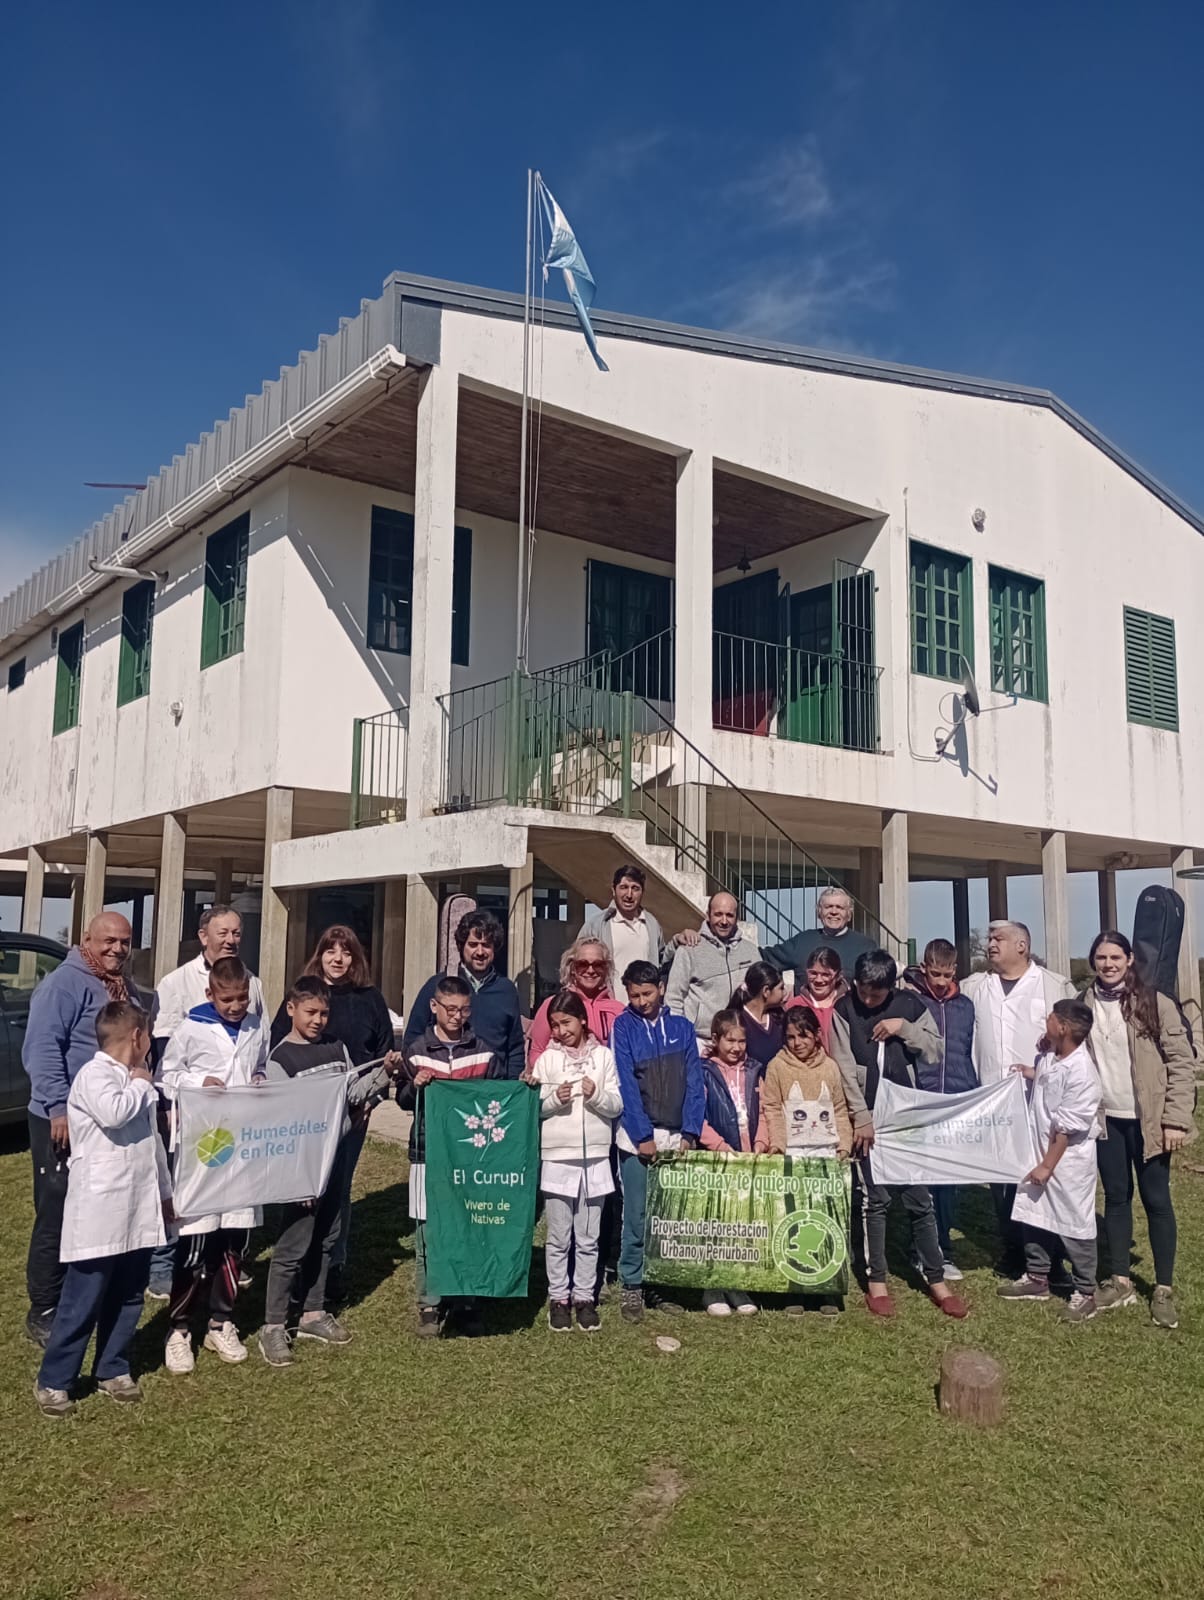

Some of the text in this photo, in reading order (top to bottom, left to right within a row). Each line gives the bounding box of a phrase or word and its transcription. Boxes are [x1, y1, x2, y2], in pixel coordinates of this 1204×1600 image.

[240, 1119, 328, 1141] Humedales
[934, 1129, 983, 1145] en Red
[240, 1139, 296, 1160] en Red
[453, 1166, 527, 1188] El Curupí
[660, 1164, 844, 1198] Gualeguay te quiero verde
[464, 1198, 511, 1211] Vivero de
[471, 1213, 506, 1225] Nativas
[651, 1216, 769, 1239] Proyecto de Forestación
[661, 1240, 760, 1264] Urbano y Periurbano
